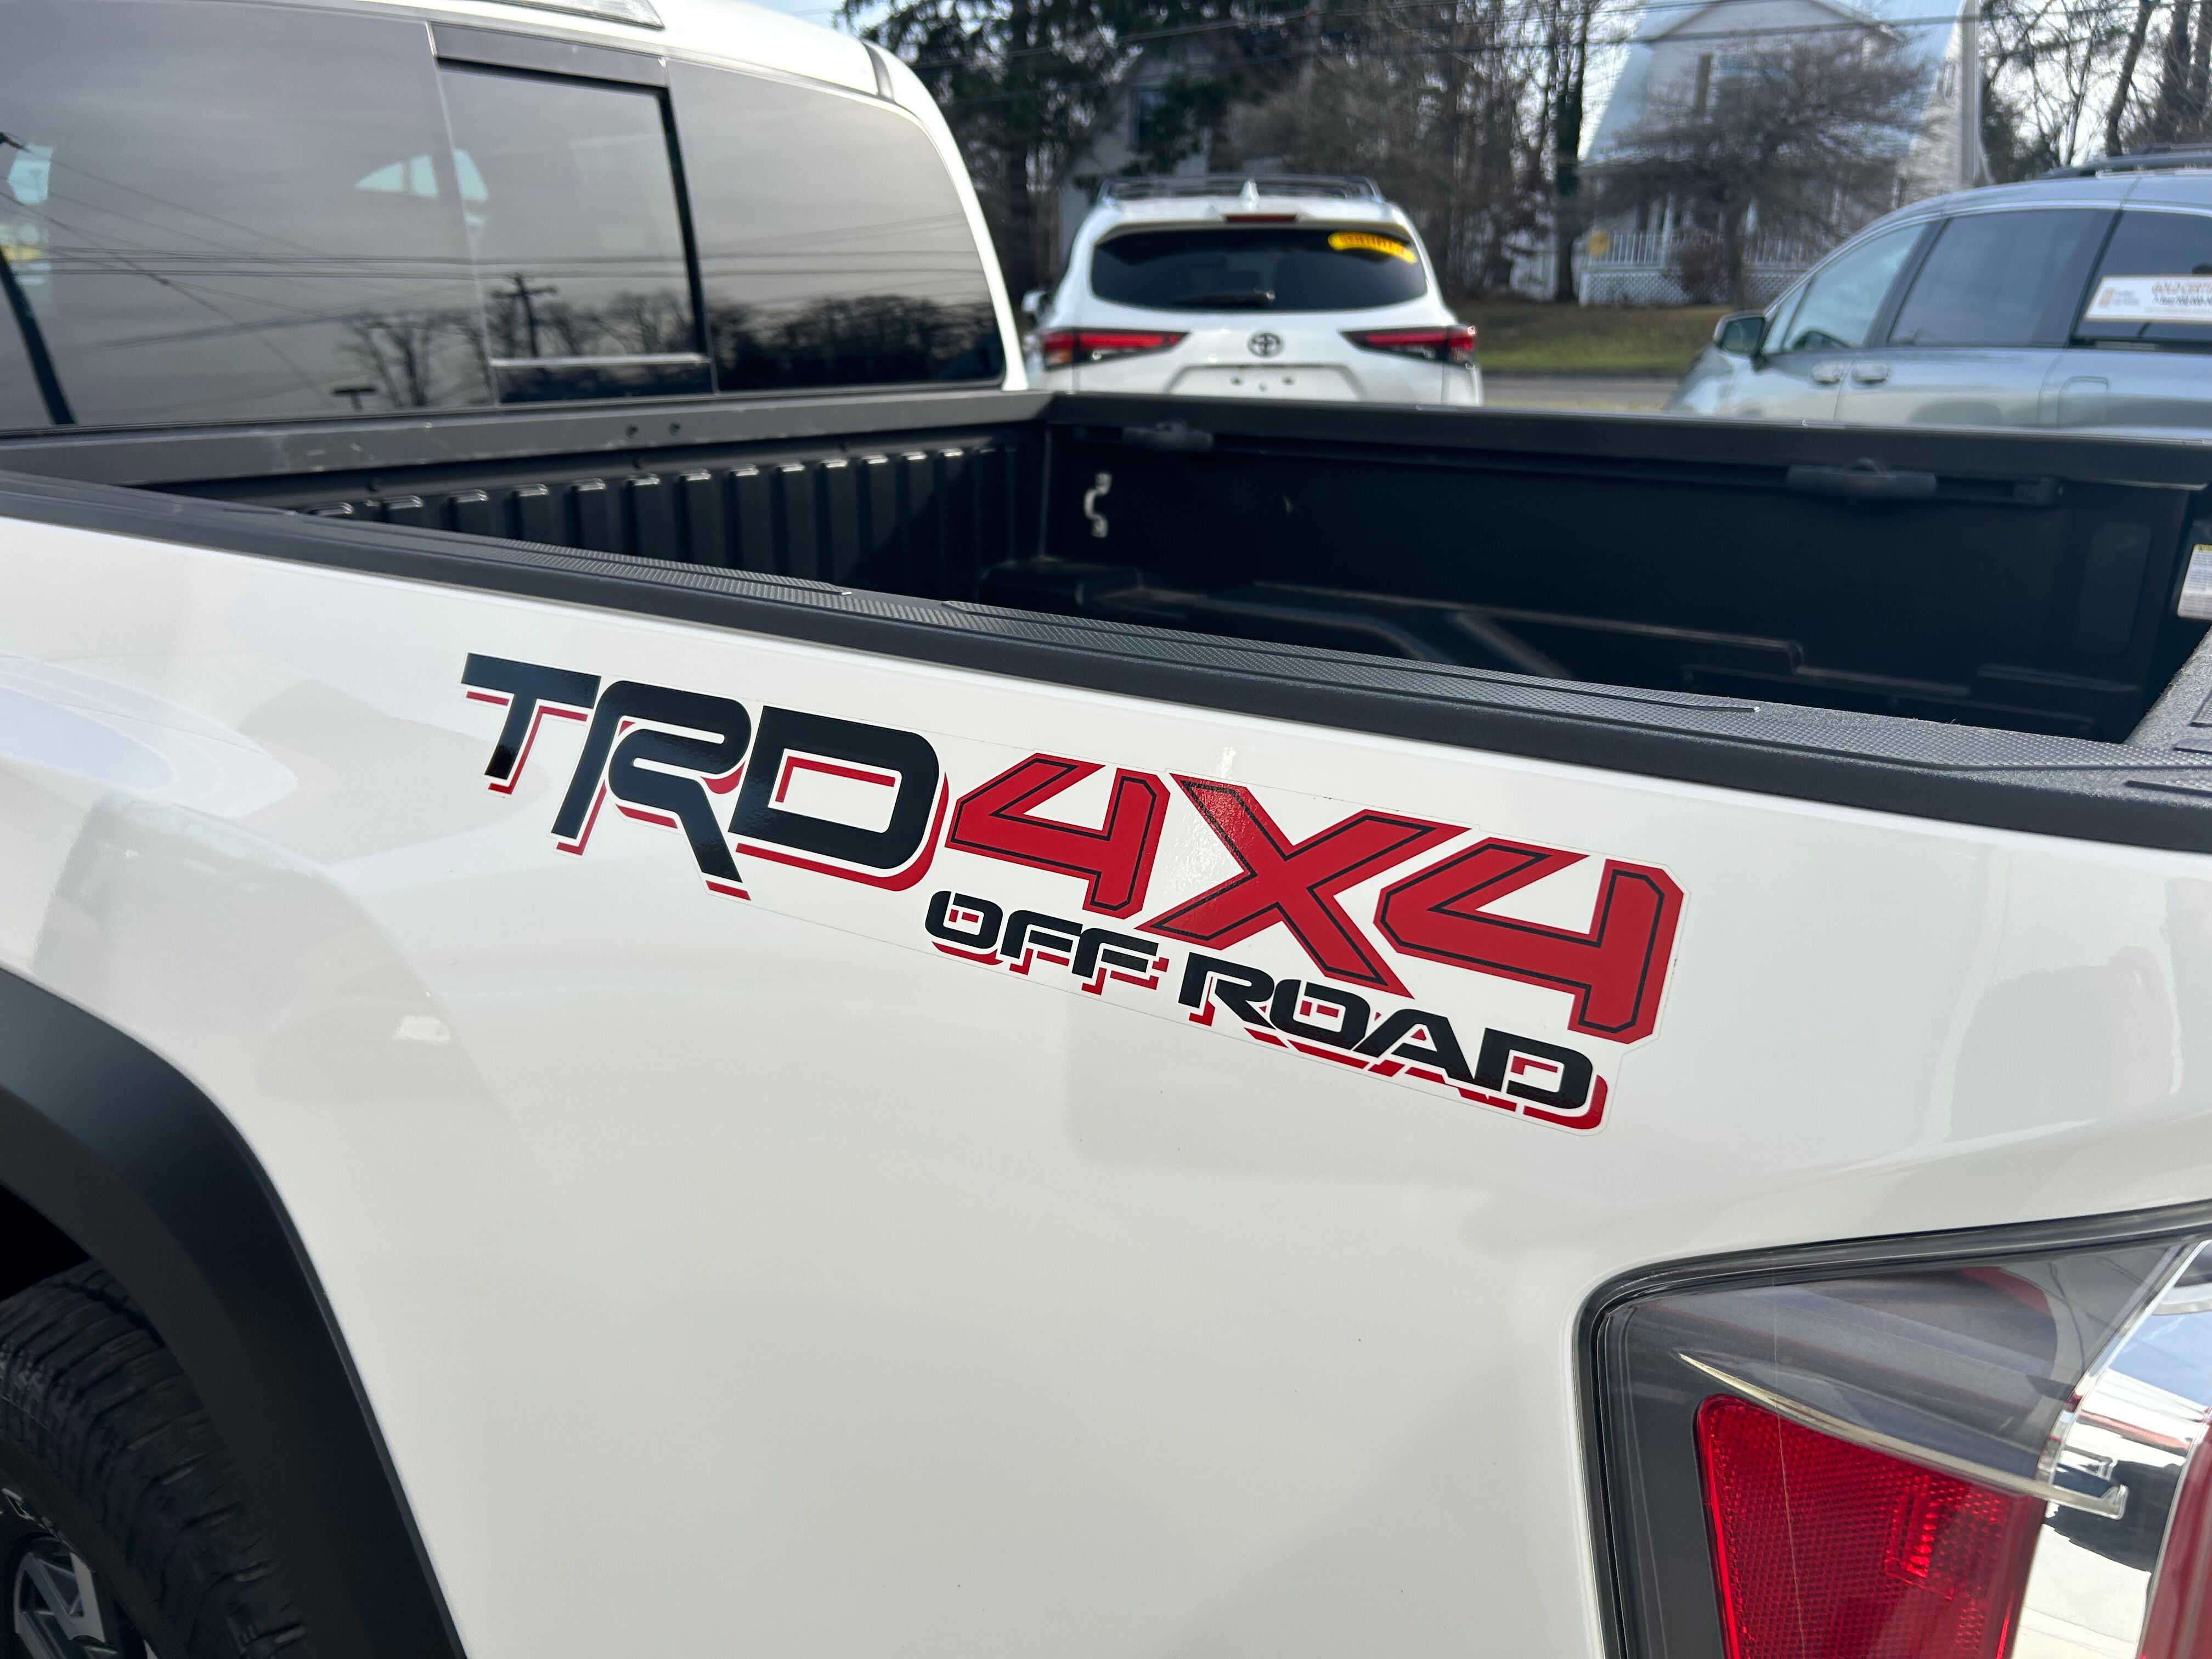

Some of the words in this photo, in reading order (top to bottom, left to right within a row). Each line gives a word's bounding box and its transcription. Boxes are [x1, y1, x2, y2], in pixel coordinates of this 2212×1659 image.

[460, 652, 949, 901] TRD
[924, 890, 1171, 996] OFF
[1178, 951, 1609, 1130] ROAD
